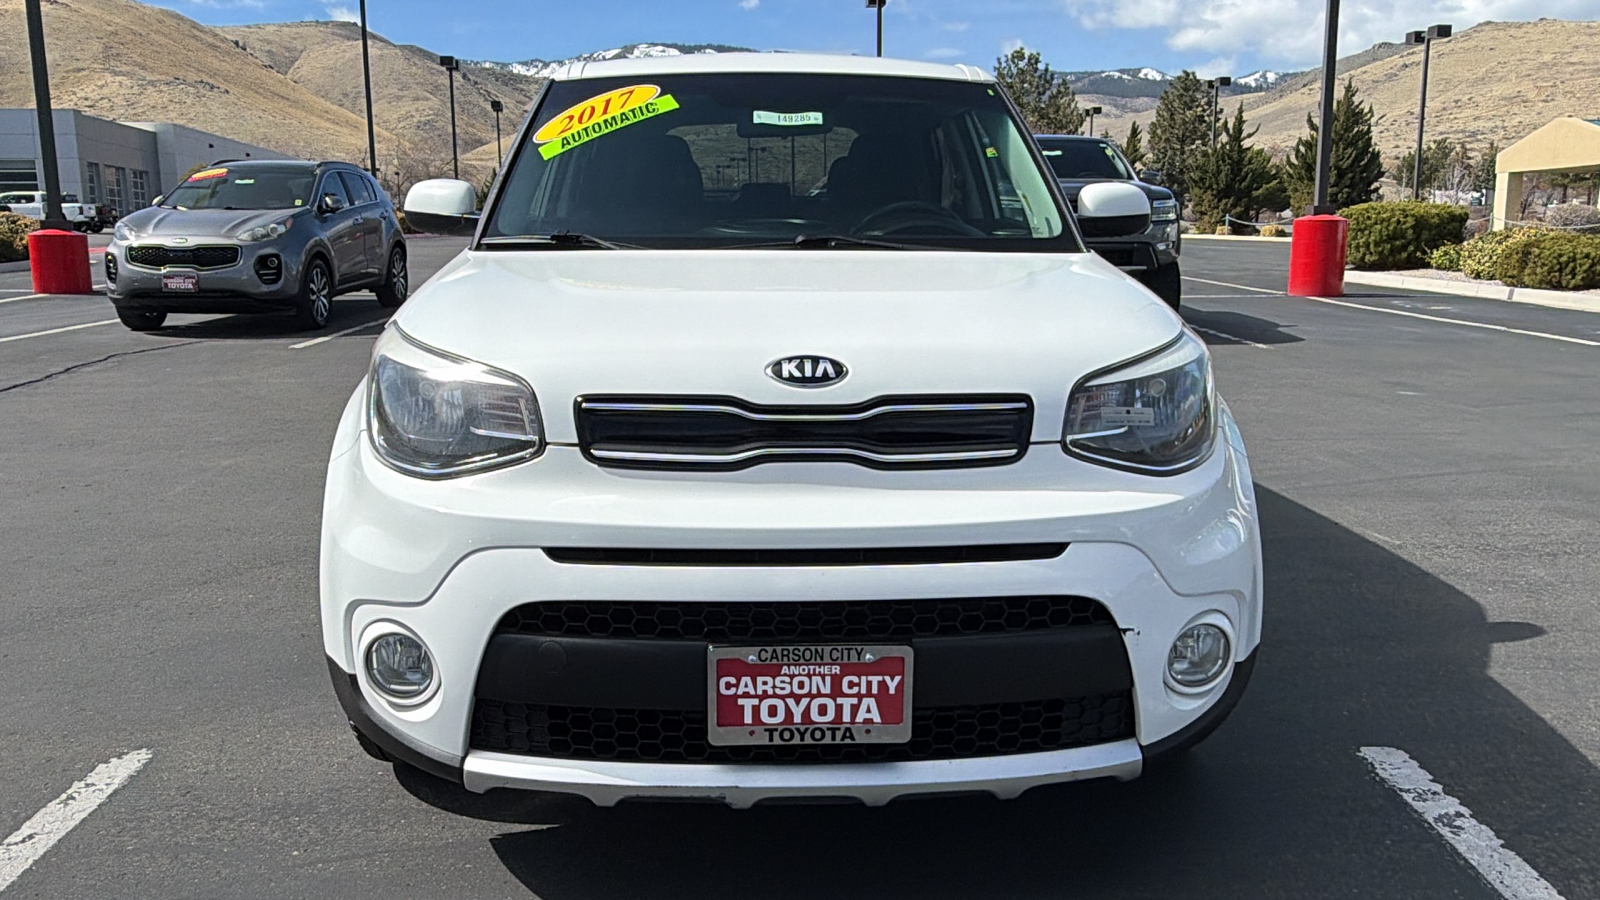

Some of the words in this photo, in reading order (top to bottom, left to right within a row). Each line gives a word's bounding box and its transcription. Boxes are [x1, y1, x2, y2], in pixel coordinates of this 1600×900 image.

[556, 88, 636, 136] 2017
[560, 102, 660, 150] AUTOMATIC
[781, 358, 836, 378] KIA
[757, 648, 824, 662] CARSON
[829, 648, 864, 661] CITY
[780, 665, 841, 675] ANOTHER
[719, 676, 831, 695] CARSON
[842, 675, 902, 694] CITY
[737, 697, 882, 724] TOYOTA
[764, 727, 856, 742] TOYOTA
